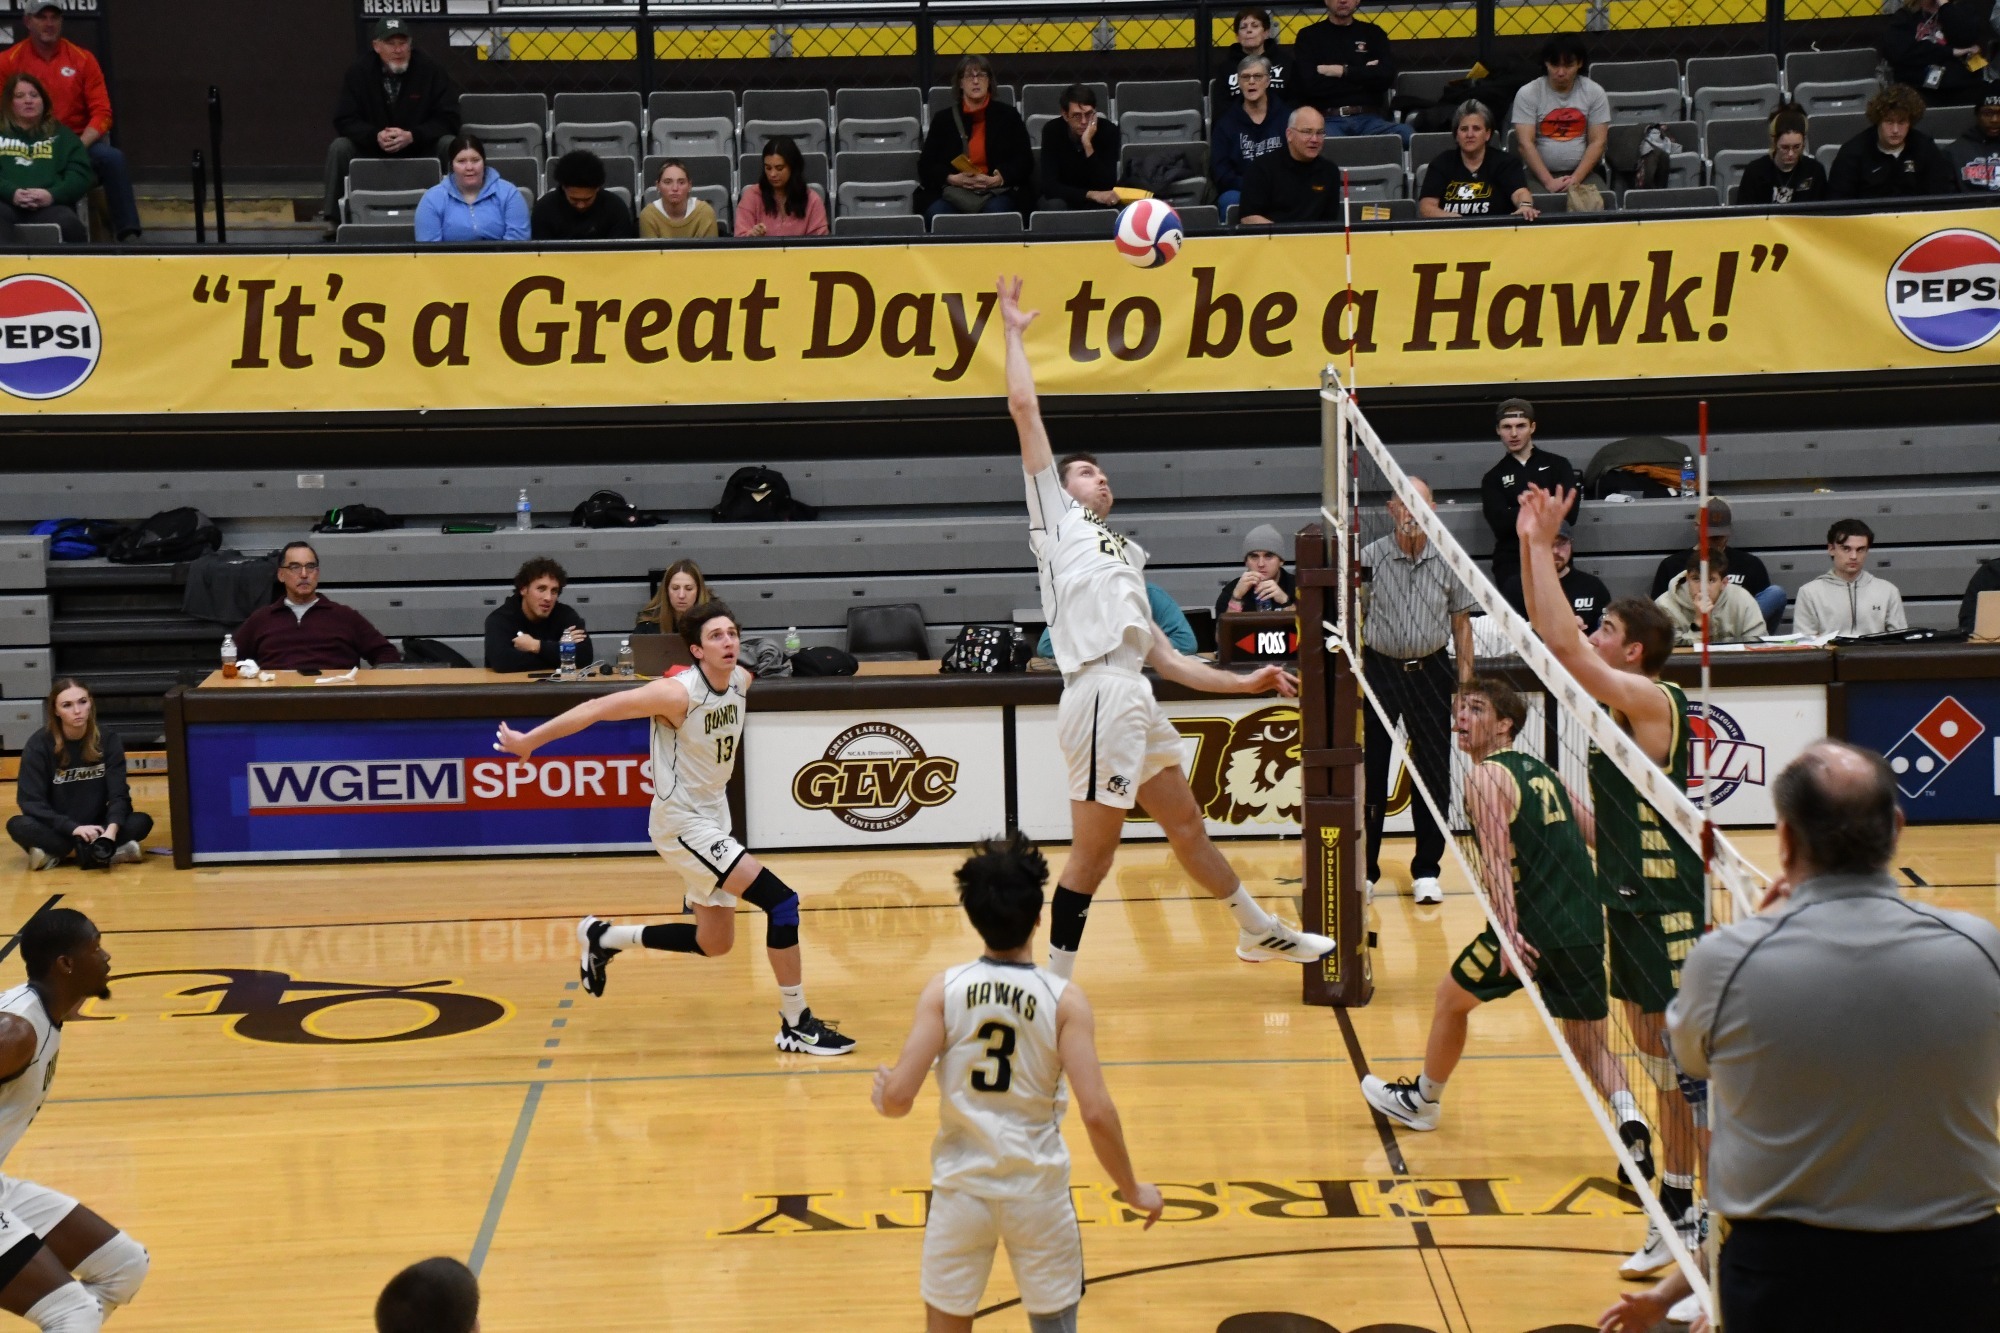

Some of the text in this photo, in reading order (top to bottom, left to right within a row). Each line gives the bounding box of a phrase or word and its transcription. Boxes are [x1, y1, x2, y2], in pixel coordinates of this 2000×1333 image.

[364, 0, 440, 13] RESERVED
[1444, 202, 1490, 214] HAWKS
[1896, 277, 2000, 304] PEPS
[0, 325, 91, 349] EPSI
[413, 301, 469, 368] a
[499, 275, 779, 366] Great
[802, 270, 998, 382] Day
[1065, 280, 1161, 362] to
[1187, 266, 1298, 358] be
[1321, 289, 1378, 355] a
[1574, 597, 1594, 610] QU
[1258, 632, 1285, 654] POSS
[705, 704, 738, 734] QUINCY
[716, 736, 733, 763] 13
[829, 725, 920, 756] GREAT LAKES VALLEY
[254, 763, 459, 802] WGEM
[793, 757, 958, 809] GLVC
[844, 813, 908, 829] CONFERENCE
[966, 981, 1037, 1021] HAWKS
[971, 1021, 1016, 1092] 3
